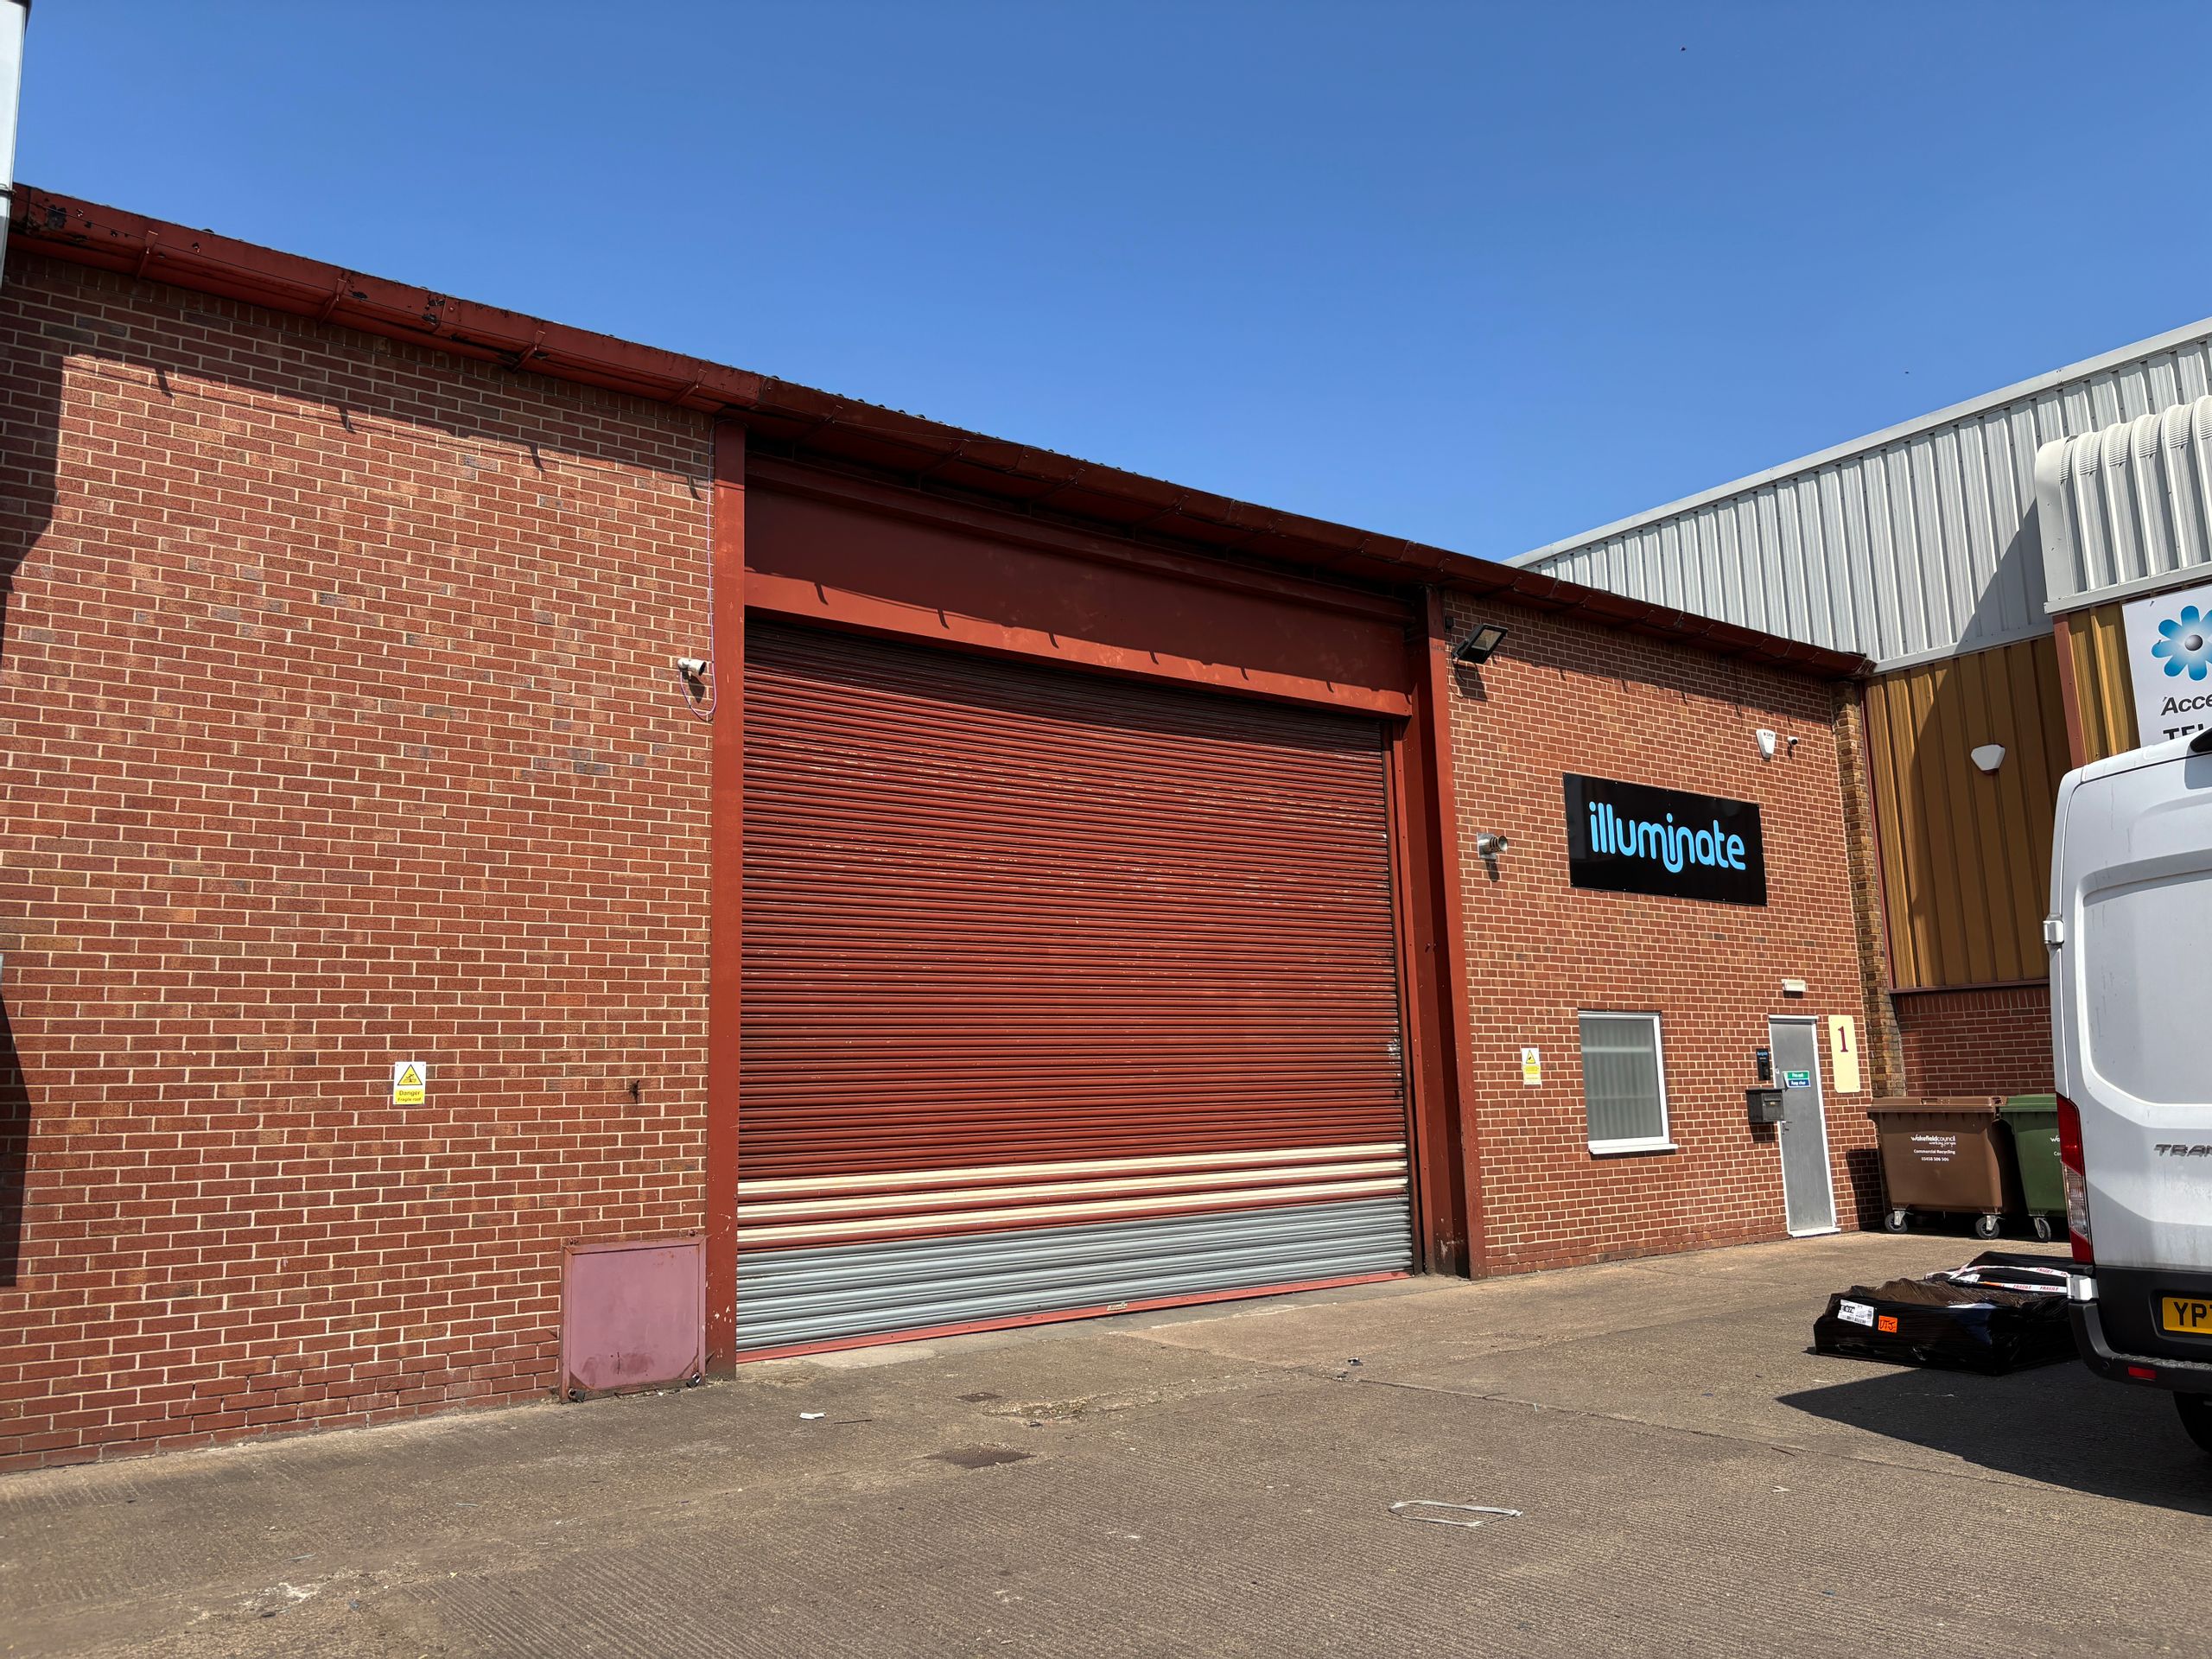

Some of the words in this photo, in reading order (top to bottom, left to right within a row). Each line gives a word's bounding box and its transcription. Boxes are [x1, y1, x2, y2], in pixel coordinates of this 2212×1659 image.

[1589, 801, 1746, 874] illuminate
[1837, 1026, 1848, 1052] 1
[2172, 1301, 2212, 1327] YP
